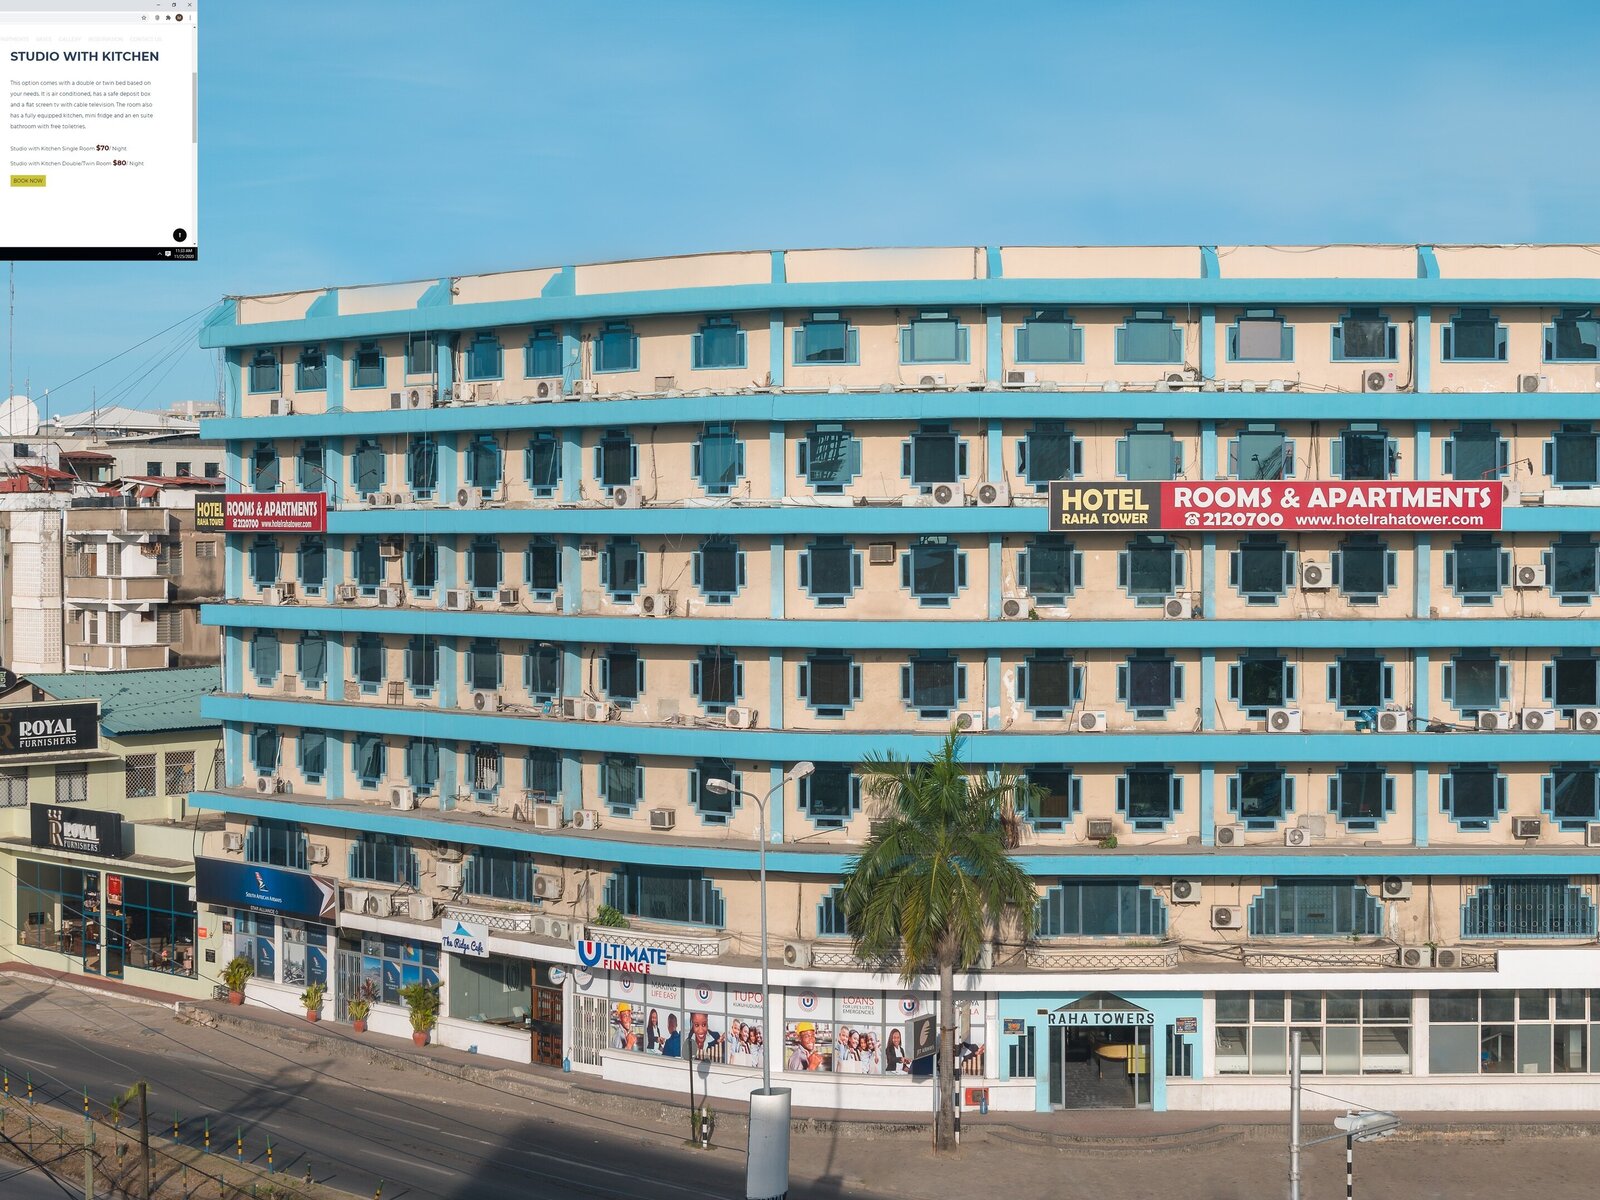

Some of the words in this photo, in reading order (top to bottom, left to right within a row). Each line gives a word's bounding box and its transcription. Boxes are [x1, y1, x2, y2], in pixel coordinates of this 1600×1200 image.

[1062, 489, 1149, 511] HOTEL
[1174, 487, 1272, 508] ROOMS
[1280, 488, 1300, 508] &
[1307, 487, 1491, 508] APARTMENTS
[197, 502, 224, 517] HOTEL
[227, 502, 254, 516] ROOMS
[256, 502, 262, 516] &
[264, 502, 317, 516] APARTMENTS
[238, 519, 259, 528] 2120700
[1062, 513, 1099, 524] RAHA
[1102, 513, 1148, 524] TOWER
[1203, 512, 1284, 526] 2120700
[1296, 513, 1483, 525] www.hotelrahatower.com
[20, 718, 76, 736] ROYAL
[20, 736, 77, 748] FURNISHERS
[63, 821, 97, 840] ROYAL
[64, 840, 98, 852] FURNISHERS
[442, 936, 453, 947] The
[454, 938, 470, 954] Ridge
[471, 941, 484, 955] Cafe
[578, 940, 667, 967] ULTIMATE
[603, 960, 650, 975] FINANCE
[651, 981, 677, 991] MAKING
[651, 990, 662, 998] LIFE
[733, 991, 763, 1003] TUPO
[843, 996, 875, 1005] LOANS
[1048, 1013, 1088, 1024] RAHA
[1094, 1013, 1155, 1024] TOWERS
